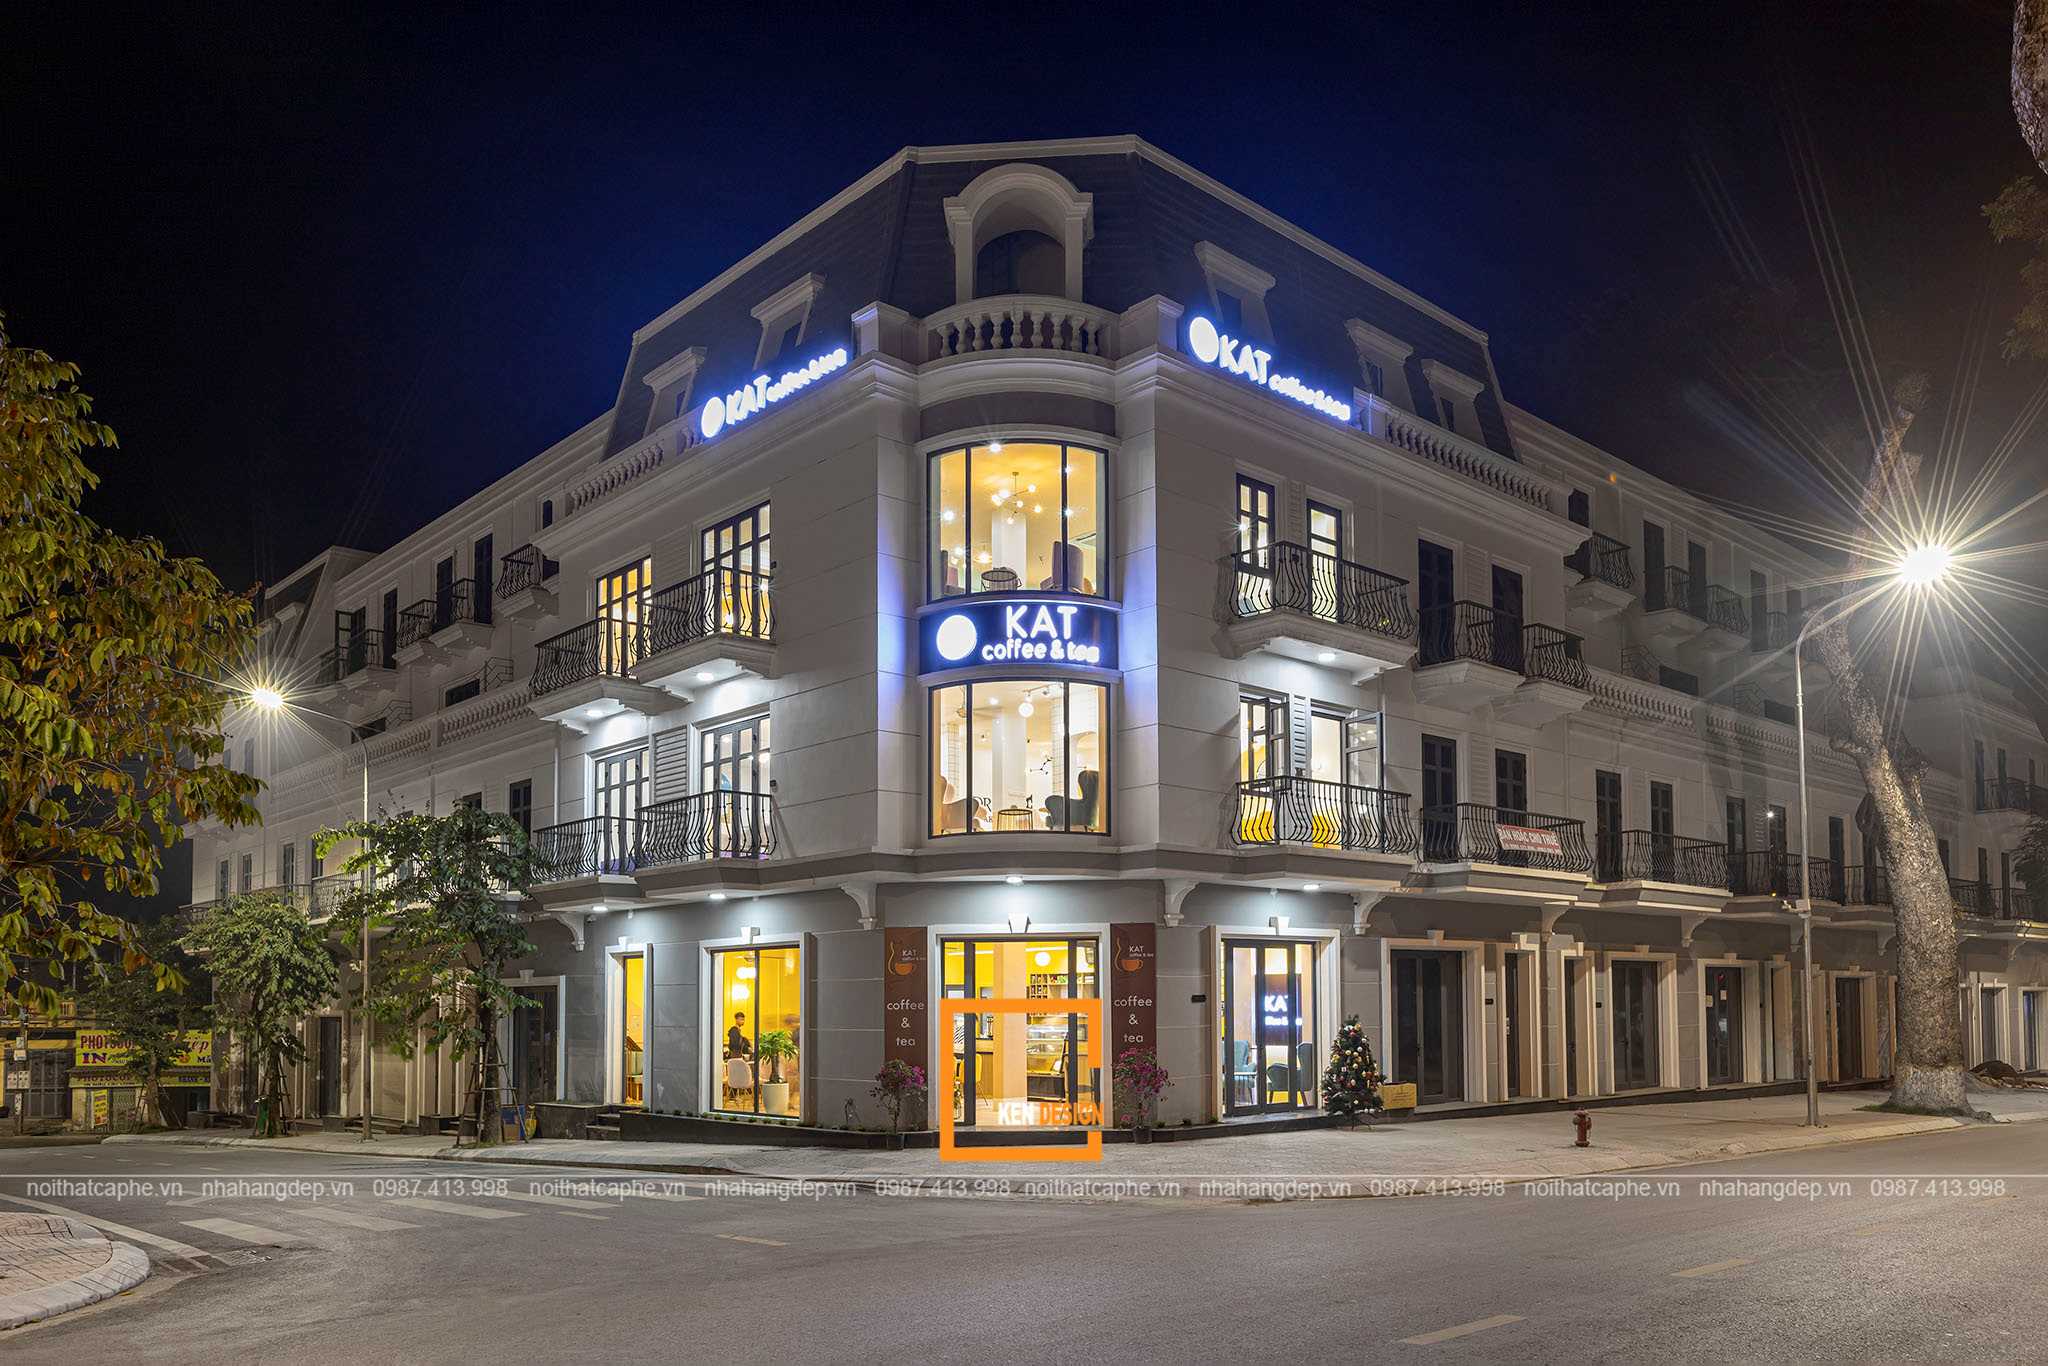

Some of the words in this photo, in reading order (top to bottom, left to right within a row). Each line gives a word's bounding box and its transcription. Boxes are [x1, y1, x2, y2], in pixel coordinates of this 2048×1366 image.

[1219, 335, 1271, 384] KAT
[726, 375, 771, 425] KAT
[1006, 605, 1078, 640] KAT
[982, 638, 1047, 661] coffee
[1050, 639, 1065, 659] &
[1067, 641, 1100, 663] tea
[902, 949, 916, 957] KAT
[887, 999, 925, 1011] coffee
[1114, 996, 1153, 1007] coffee
[1264, 995, 1288, 1012] KA
[901, 1017, 911, 1028] &
[1128, 1014, 1138, 1025] &
[896, 1037, 915, 1046] tea
[1124, 1034, 1144, 1043] tea
[83, 1052, 108, 1064] IN
